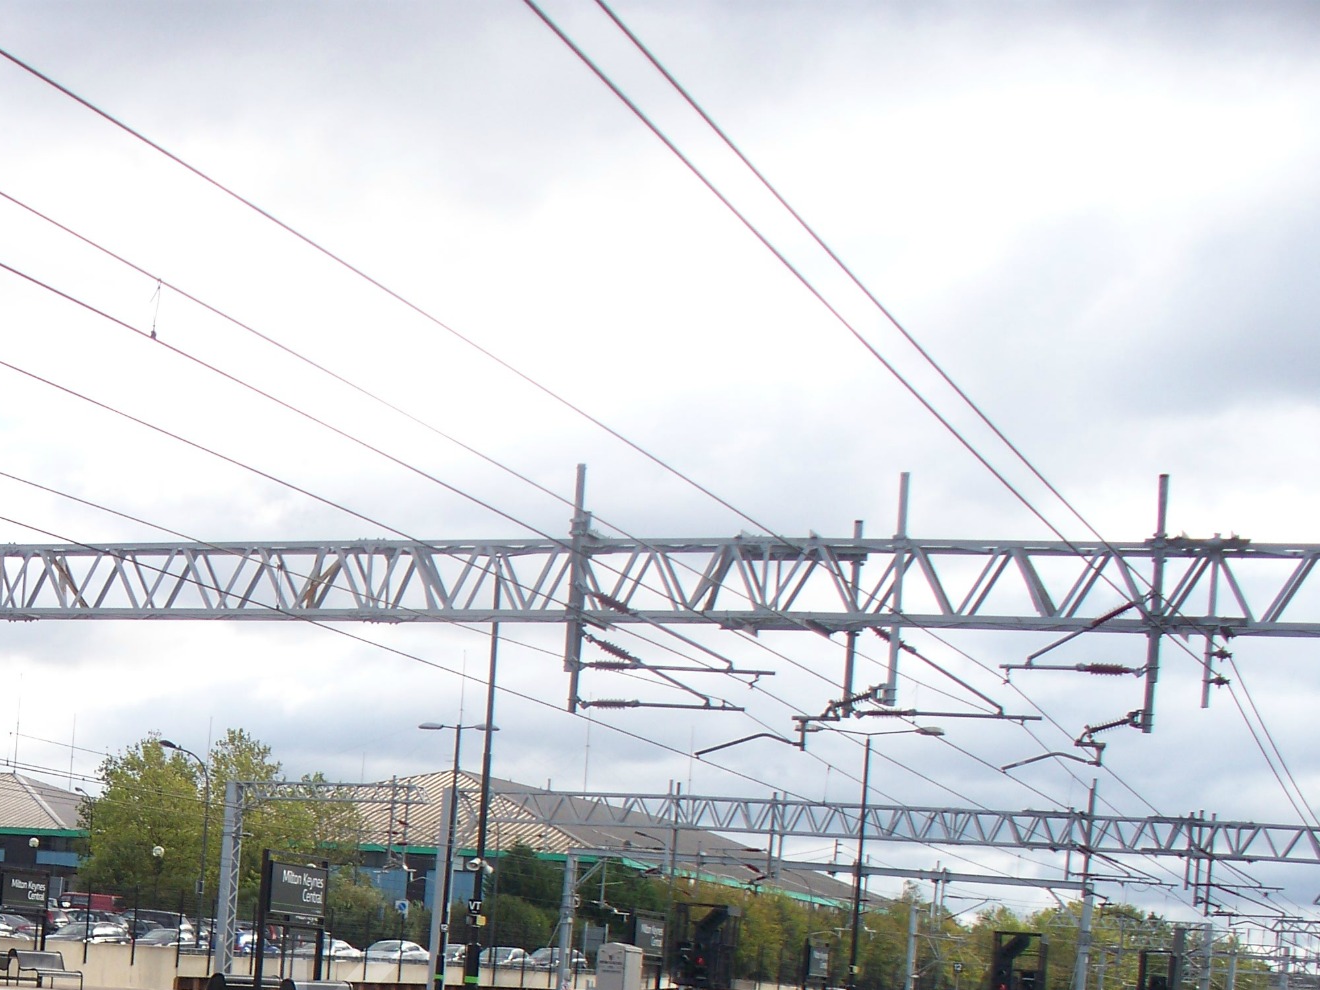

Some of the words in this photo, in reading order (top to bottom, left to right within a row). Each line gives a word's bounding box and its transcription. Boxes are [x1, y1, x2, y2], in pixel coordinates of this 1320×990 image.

[282, 869, 302, 885] Milton
[303, 873, 324, 890] Keynes
[302, 888, 323, 904] Central
[468, 901, 482, 911] VT
